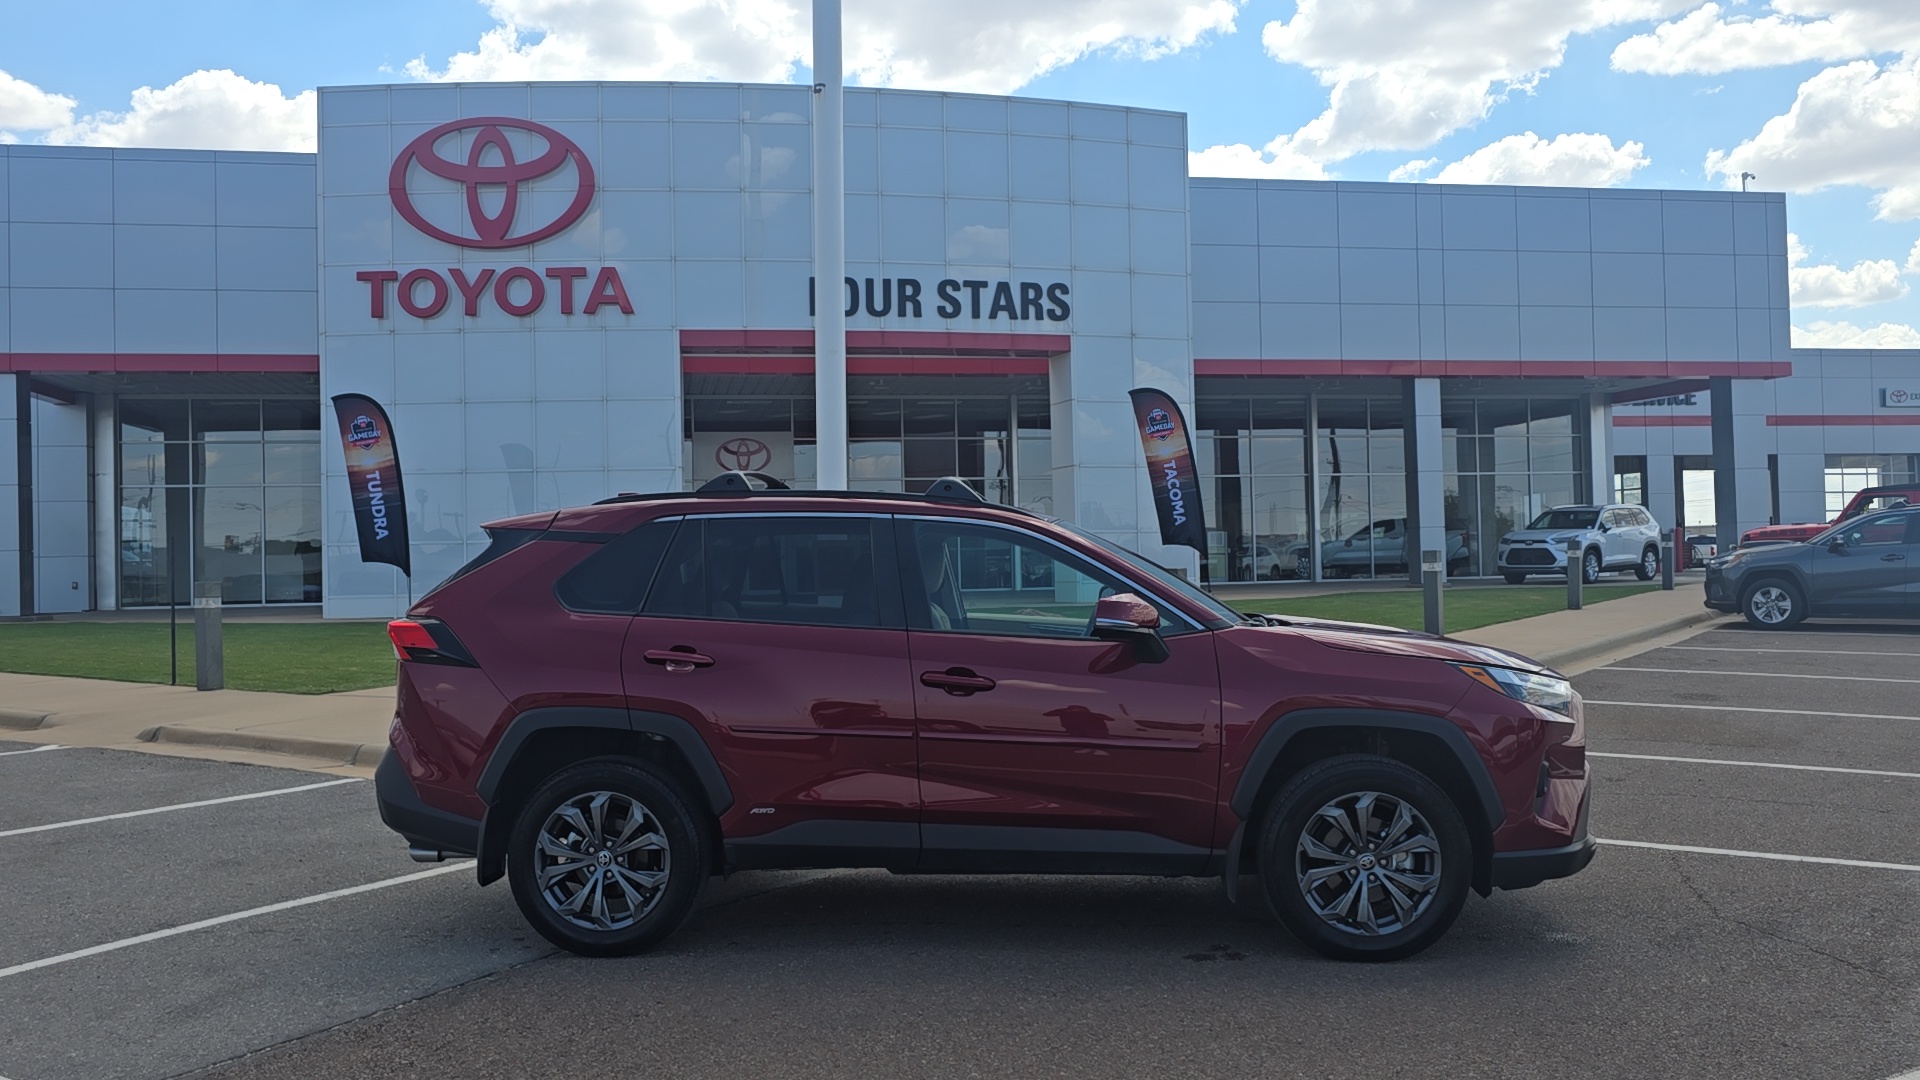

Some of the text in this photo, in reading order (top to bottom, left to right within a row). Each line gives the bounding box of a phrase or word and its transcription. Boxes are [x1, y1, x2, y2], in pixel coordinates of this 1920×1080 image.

[356, 266, 635, 319] TOYOTA
[809, 276, 1070, 321] OUR STARS
[348, 430, 381, 442] GAMEDAY
[1145, 422, 1175, 434] GAMEDAY
[366, 470, 389, 540] TUNDRA
[1163, 460, 1187, 526] TACOMA
